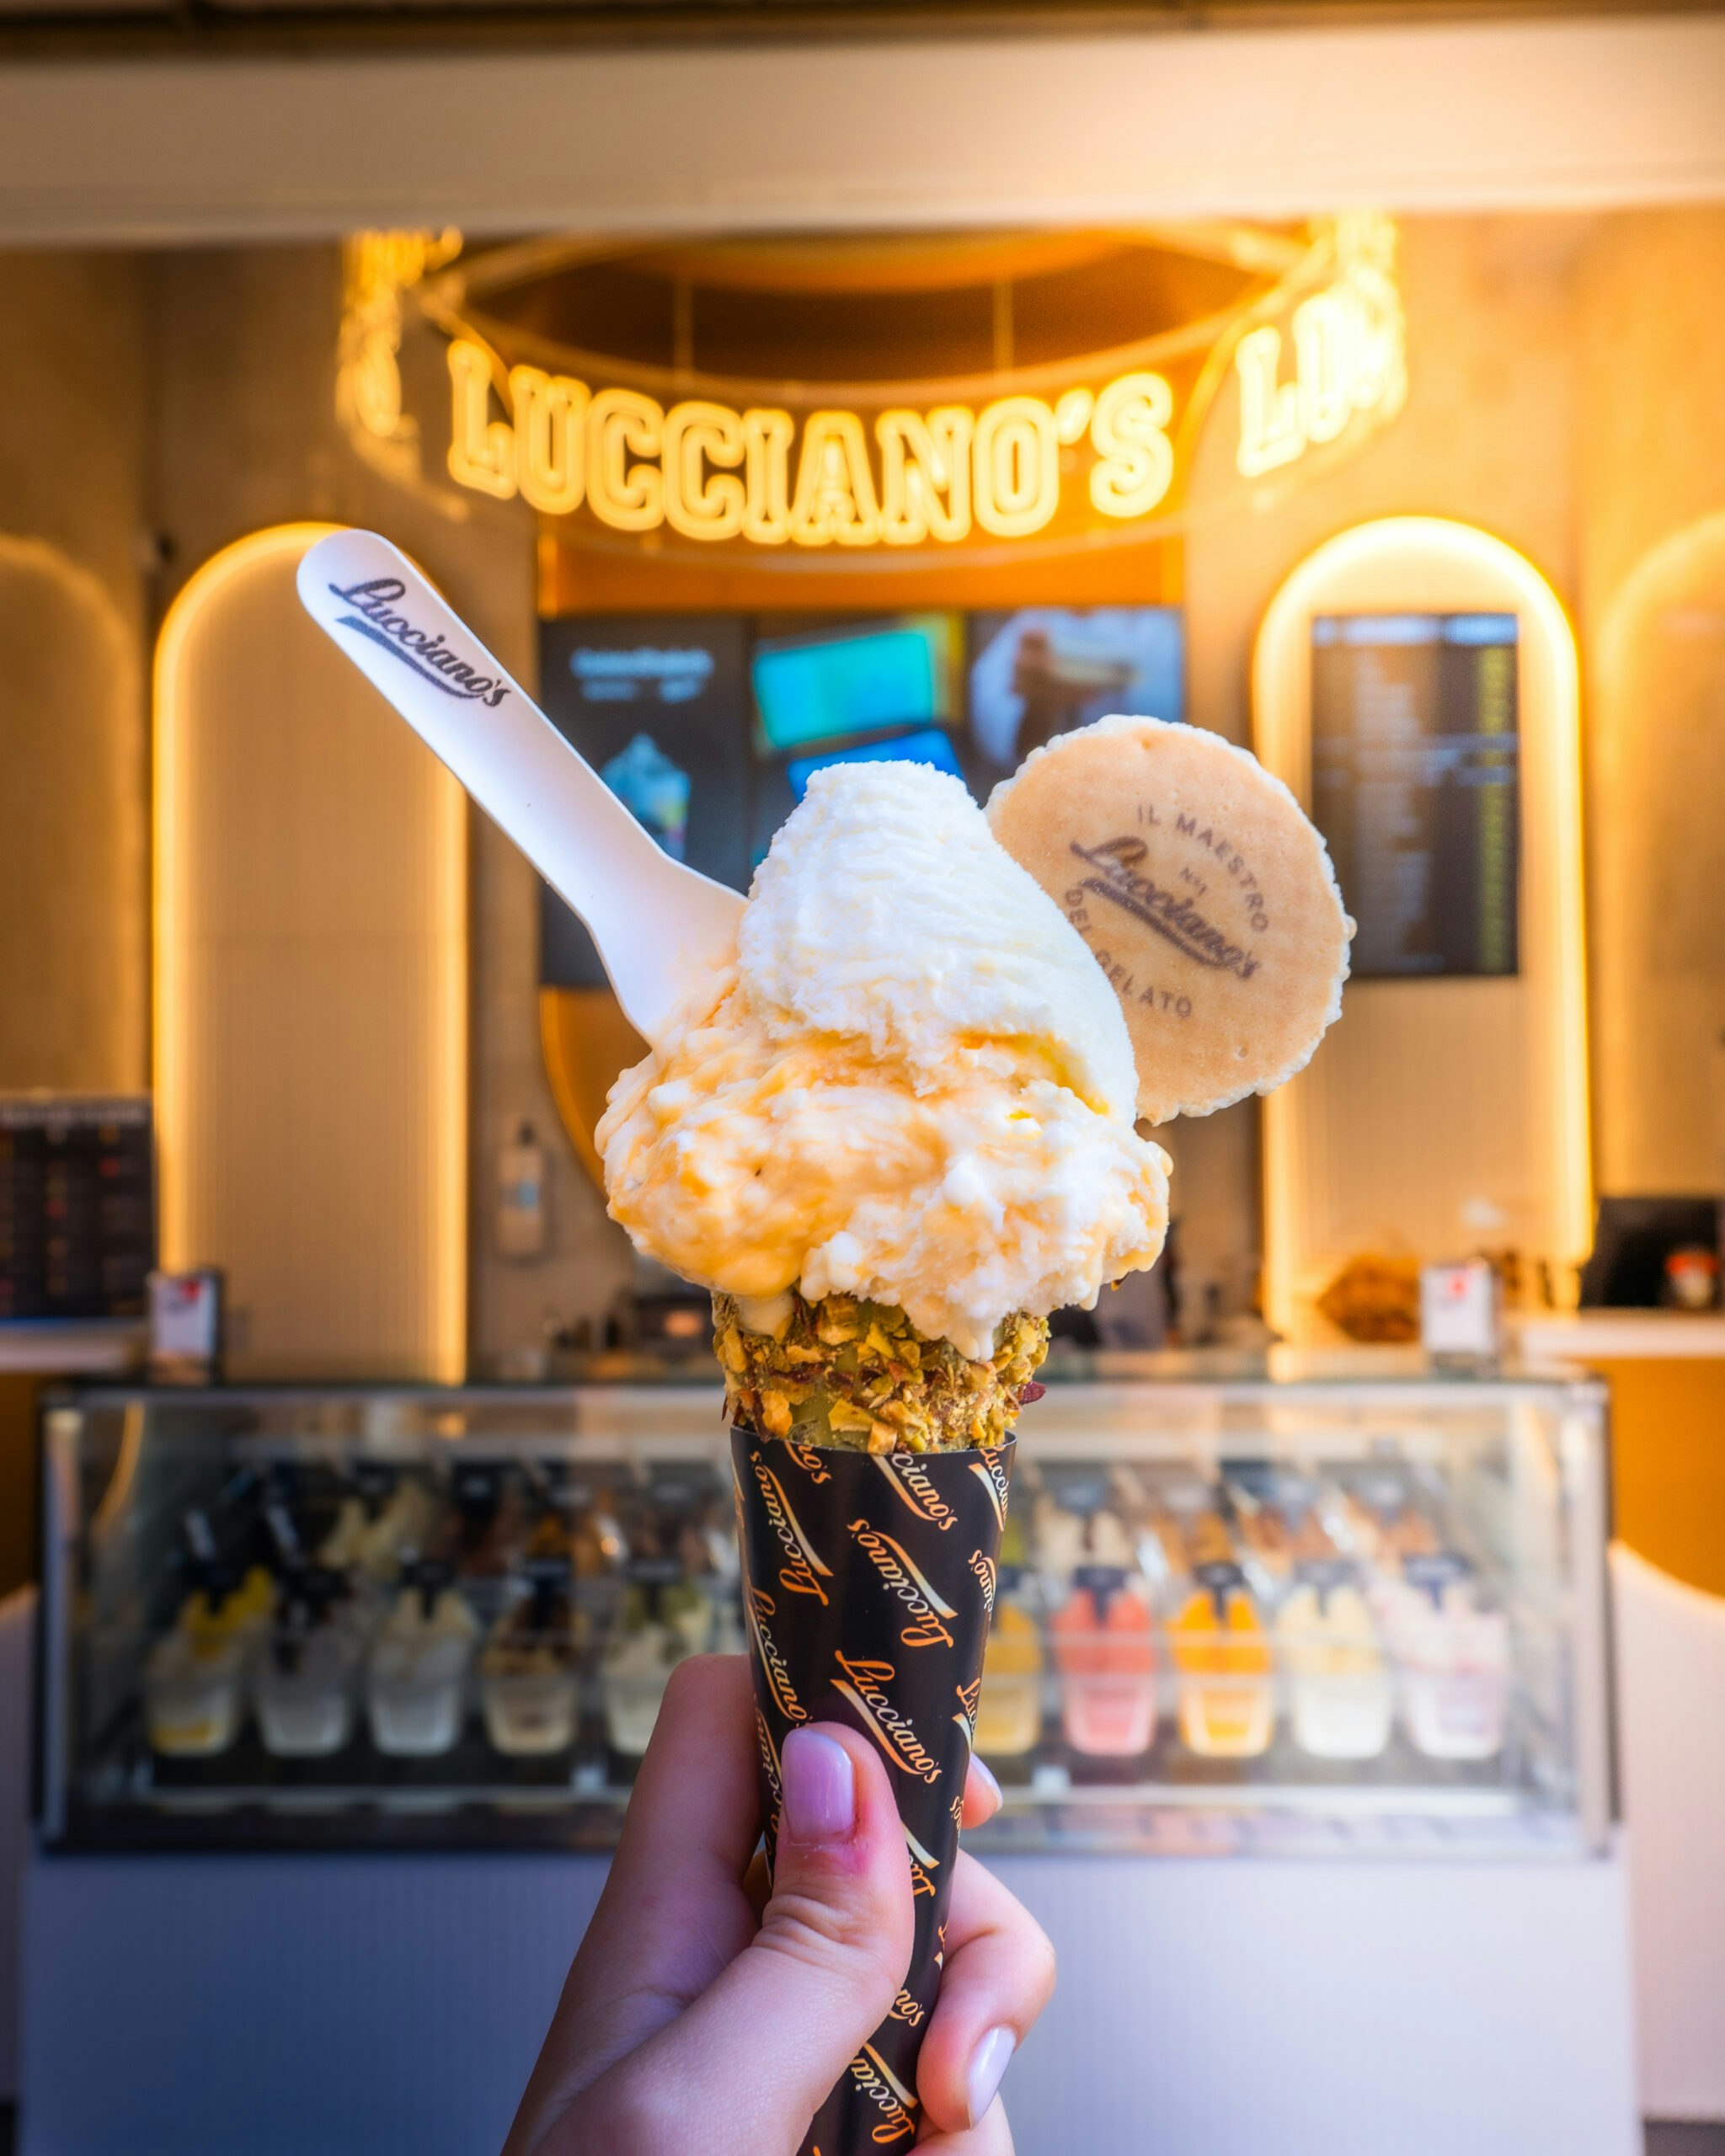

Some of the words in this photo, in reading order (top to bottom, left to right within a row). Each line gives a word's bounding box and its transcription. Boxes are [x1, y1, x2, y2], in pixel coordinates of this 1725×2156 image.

[447, 339, 1174, 545] LUCCIANO'S
[328, 578, 510, 707] Lucciano's
[1069, 835, 1261, 980] Lucciano's
[1139, 804, 1161, 825] IL
[1176, 813, 1268, 932] MAESTRO
[750, 1450, 834, 1606] Lucciano's
[847, 1518, 955, 1647] Lucciano's
[832, 1649, 942, 1784] Lucciano's
